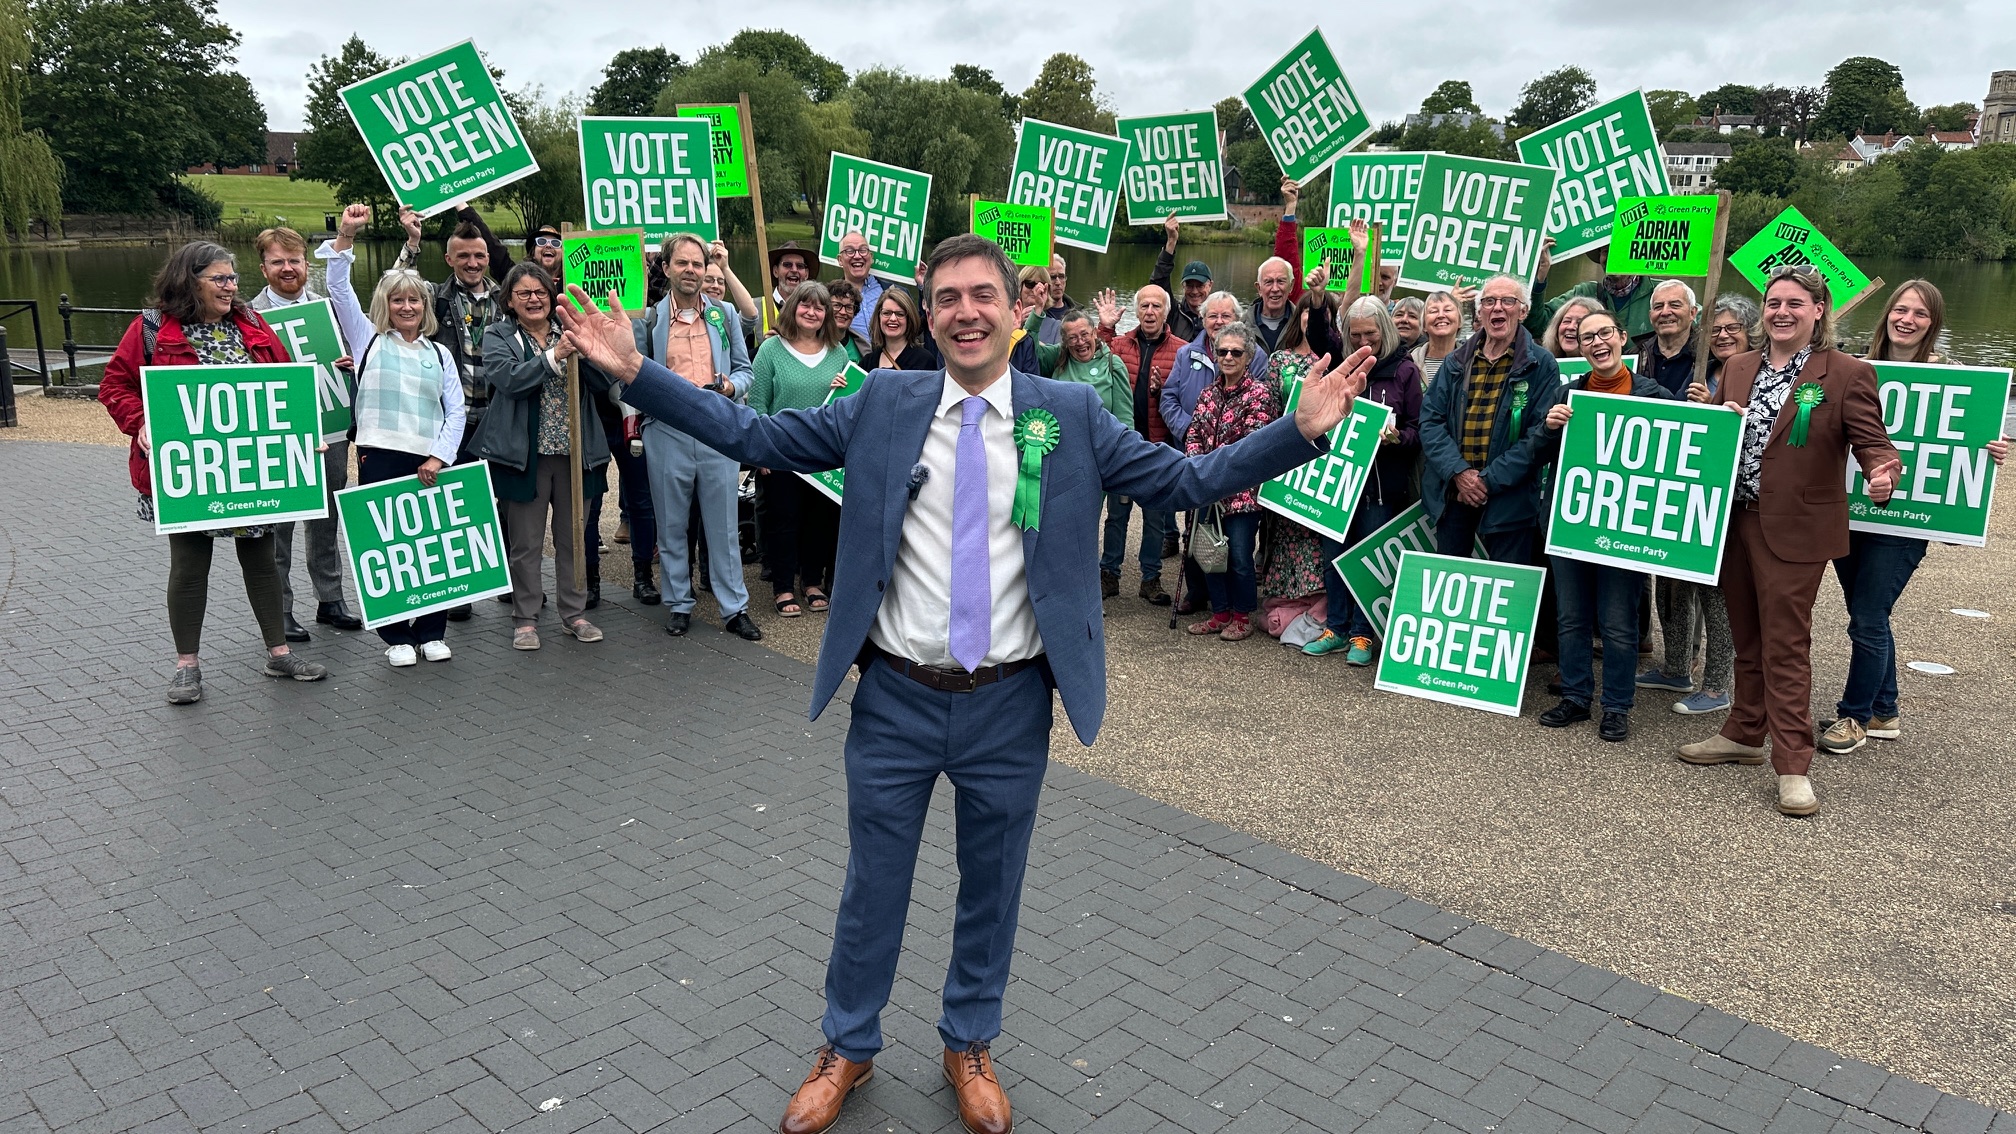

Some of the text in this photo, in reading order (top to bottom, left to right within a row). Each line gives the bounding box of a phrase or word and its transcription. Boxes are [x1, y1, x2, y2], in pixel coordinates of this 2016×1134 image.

[371, 62, 476, 135] VOTE
[1260, 50, 1326, 120] VOTE
[1271, 76, 1359, 166] GREEN
[382, 101, 518, 191] GREEN
[604, 132, 691, 175] VOTE
[713, 148, 733, 164] RTY
[1134, 123, 1201, 162] VOTE
[1318, 134, 1345, 158] Green Party
[1541, 111, 1631, 181] VOTE
[1037, 135, 1108, 184] VOTE
[453, 175, 476, 188] Green
[475, 166, 495, 179] Party
[1127, 159, 1219, 203] GREEN
[1351, 164, 1422, 200] VOTE
[1545, 148, 1663, 234] GREEN
[591, 178, 712, 225] GREEN
[848, 168, 912, 218] VOTE
[1014, 171, 1114, 229] GREEN
[1442, 169, 1531, 222] VOTE
[979, 208, 1000, 225] VOTE
[1621, 203, 1648, 226] VOTE
[1692, 206, 1712, 215] Party
[827, 204, 919, 262] GREEN
[997, 220, 1031, 238] GREEN
[1064, 226, 1080, 237] Party
[1309, 233, 1327, 252] VOTE
[1634, 220, 1690, 240] ADRIAN
[1778, 224, 1808, 244] VOTE
[569, 245, 590, 267] VOTE
[621, 244, 635, 252] Party
[997, 236, 1031, 253] PARTY
[1320, 247, 1355, 264] ADRIAN
[1386, 247, 1402, 256] Party
[1411, 213, 1537, 277] GREEN
[1629, 240, 1692, 261] RAMSAY
[584, 259, 623, 280] ADRIAN
[875, 258, 890, 269] Party
[1450, 272, 1471, 283] Gren
[1655, 261, 1669, 270] JULY
[1821, 254, 1855, 288] Green Party
[582, 278, 627, 298] RAMSAY
[177, 381, 291, 435] VOTE
[1879, 381, 1972, 440] OTE
[1596, 412, 1708, 479] VOTE
[159, 433, 317, 498] GREEN
[1272, 453, 1364, 513] REEN
[227, 499, 281, 511] Green Party
[366, 481, 470, 543] VOTE
[1293, 498, 1322, 518] Green Party
[1560, 466, 1722, 547] GREEN
[1870, 507, 1931, 523] Green Party
[359, 523, 500, 599] GREEN
[1613, 541, 1668, 560] Green Party
[422, 589, 446, 601] Green
[448, 583, 469, 595] Party
[1421, 568, 1515, 626] VOTE
[1389, 613, 1525, 684] GREEN
[1433, 677, 1479, 694] Green Party
